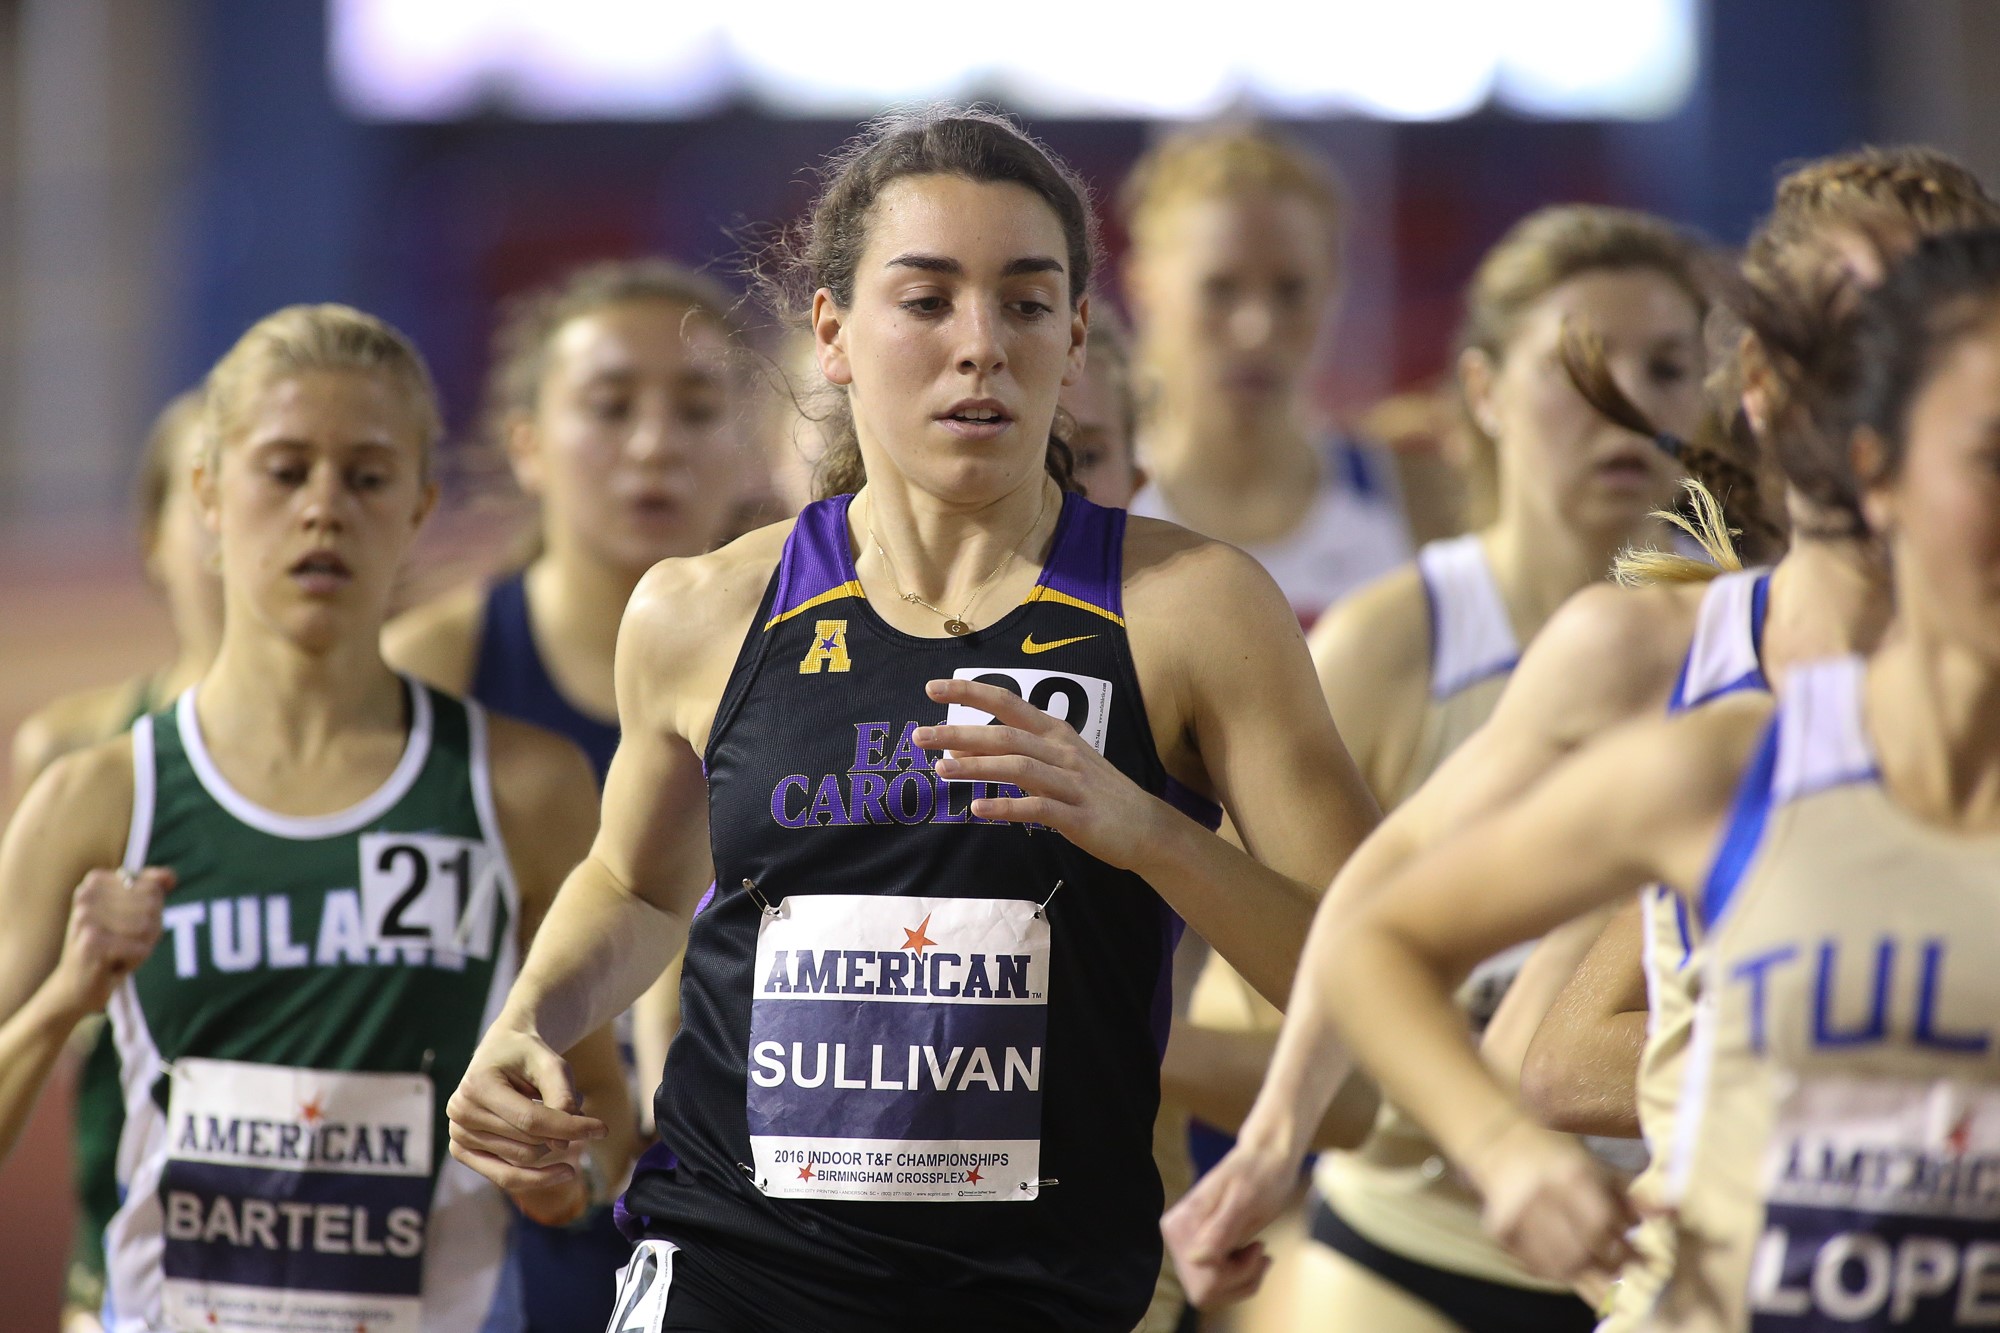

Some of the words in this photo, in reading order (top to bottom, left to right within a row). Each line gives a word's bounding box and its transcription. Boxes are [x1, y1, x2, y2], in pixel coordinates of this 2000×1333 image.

[799, 619, 851, 674] A
[378, 846, 471, 937] 21
[163, 889, 467, 979] TULA
[763, 949, 1032, 999] AMERICAN
[750, 1040, 1042, 1092] SULLIVAN
[180, 1114, 410, 1167] AMERICAN
[774, 1150, 804, 1163] 2016
[808, 1151, 862, 1165] INDOOR
[866, 1152, 893, 1167] T&F
[896, 1153, 1009, 1167] CHAMPIONSHIPS
[818, 1170, 893, 1183] BIRMINGHAM
[896, 1172, 966, 1184] CROSSPLEX
[166, 1191, 425, 1258] BARTELS
